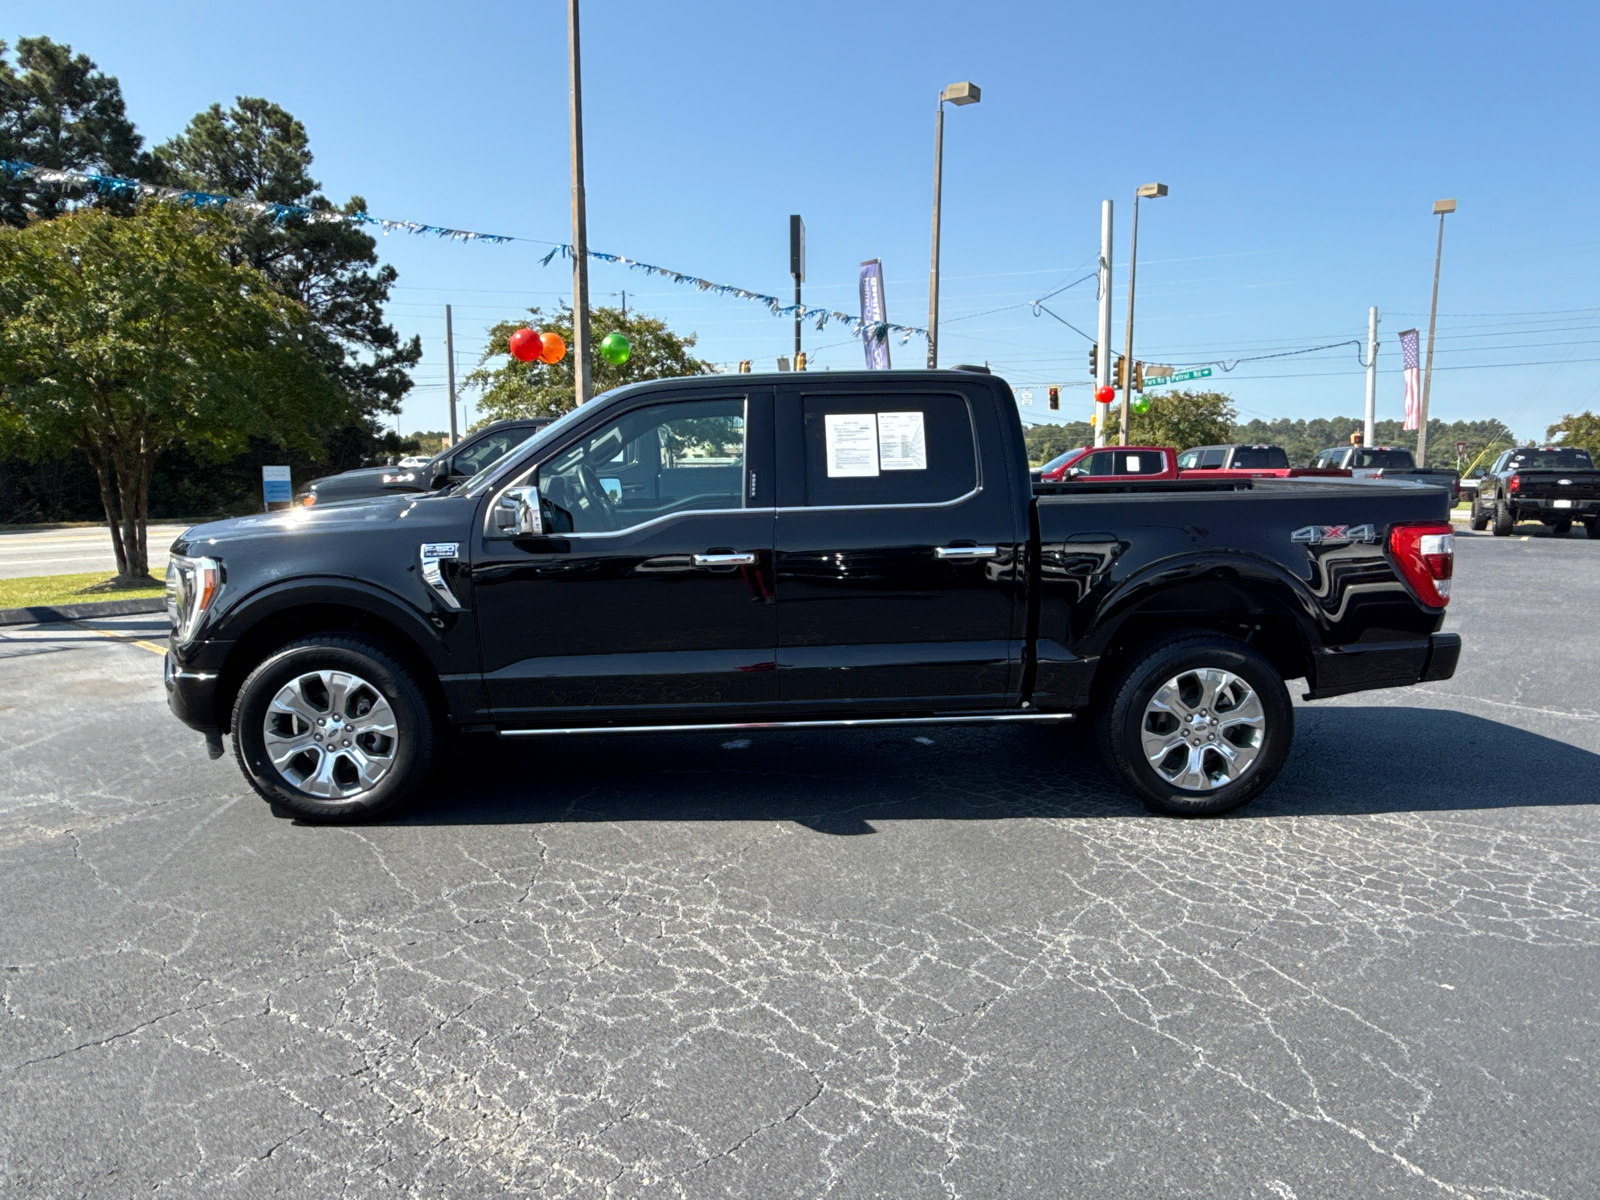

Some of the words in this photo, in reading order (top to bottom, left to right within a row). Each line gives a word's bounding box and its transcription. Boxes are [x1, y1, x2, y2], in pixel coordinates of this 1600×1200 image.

[1171, 373, 1190, 382] Patrol
[1193, 370, 1202, 378] Rd
[1144, 378, 1156, 386] Park
